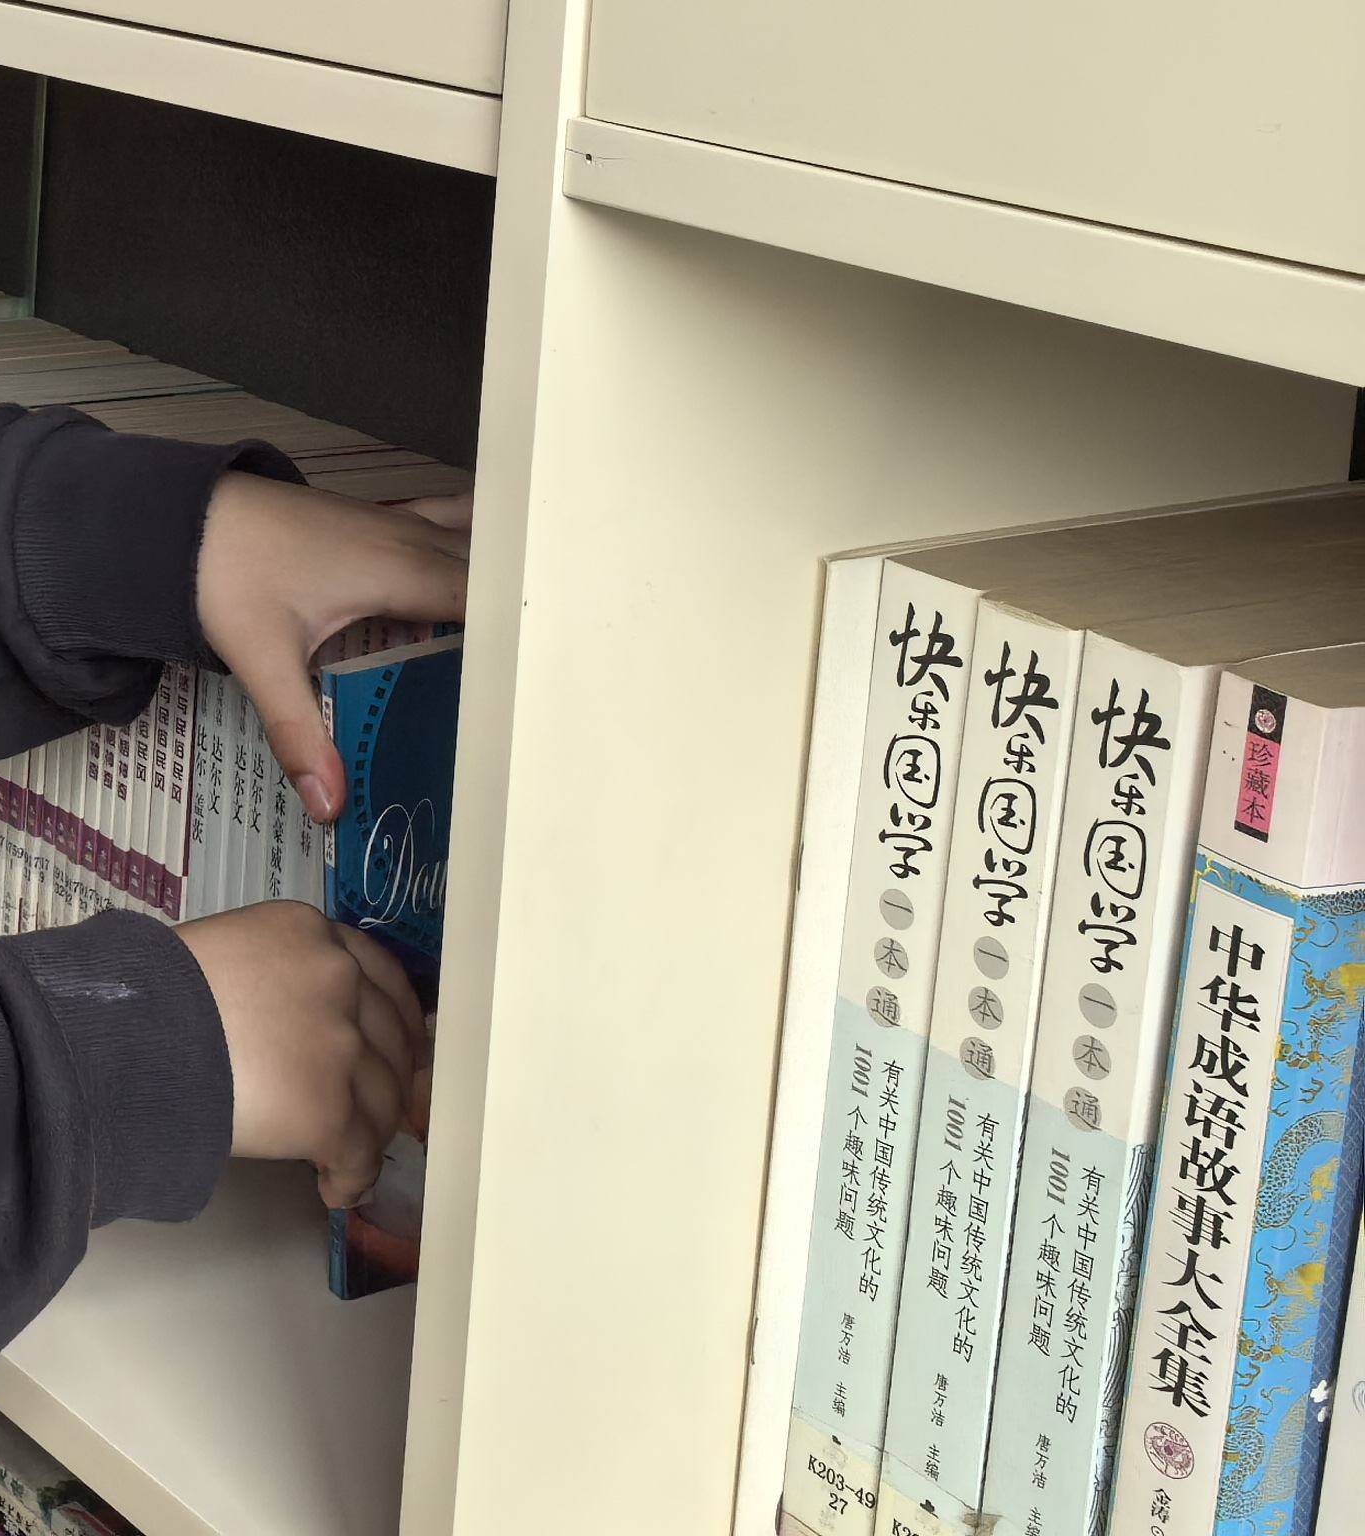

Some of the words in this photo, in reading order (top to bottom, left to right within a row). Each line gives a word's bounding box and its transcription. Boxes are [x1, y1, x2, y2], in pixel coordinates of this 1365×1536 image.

[207, 734, 223, 816] 达尔文
[232, 744, 247, 825] 达尔文
[249, 752, 265, 834] 达尔文
[850, 1042, 873, 1098] 1001
[943, 1094, 968, 1153] 1001
[833, 1105, 869, 1242] 个趣味问题
[857, 1058, 906, 1302] 有关中国传统文化的
[1046, 1146, 1072, 1206] 1001
[1148, 924, 1266, 1420] 中华成语故事大全集
[925, 1159, 963, 1300] 个趣味问题
[952, 1112, 1000, 1364] 有关中国传统文化的
[1026, 1213, 1067, 1358] 个趣味问题
[1055, 1165, 1107, 1424] 有关中国传统文化的
[837, 1311, 857, 1366] 唐万洁
[831, 1381, 848, 1418] 主编
[929, 1372, 950, 1428] 唐万洁
[924, 1442, 943, 1482] 主编
[1031, 1432, 1052, 1490] 唐万洁
[828, 1492, 849, 1515] 27
